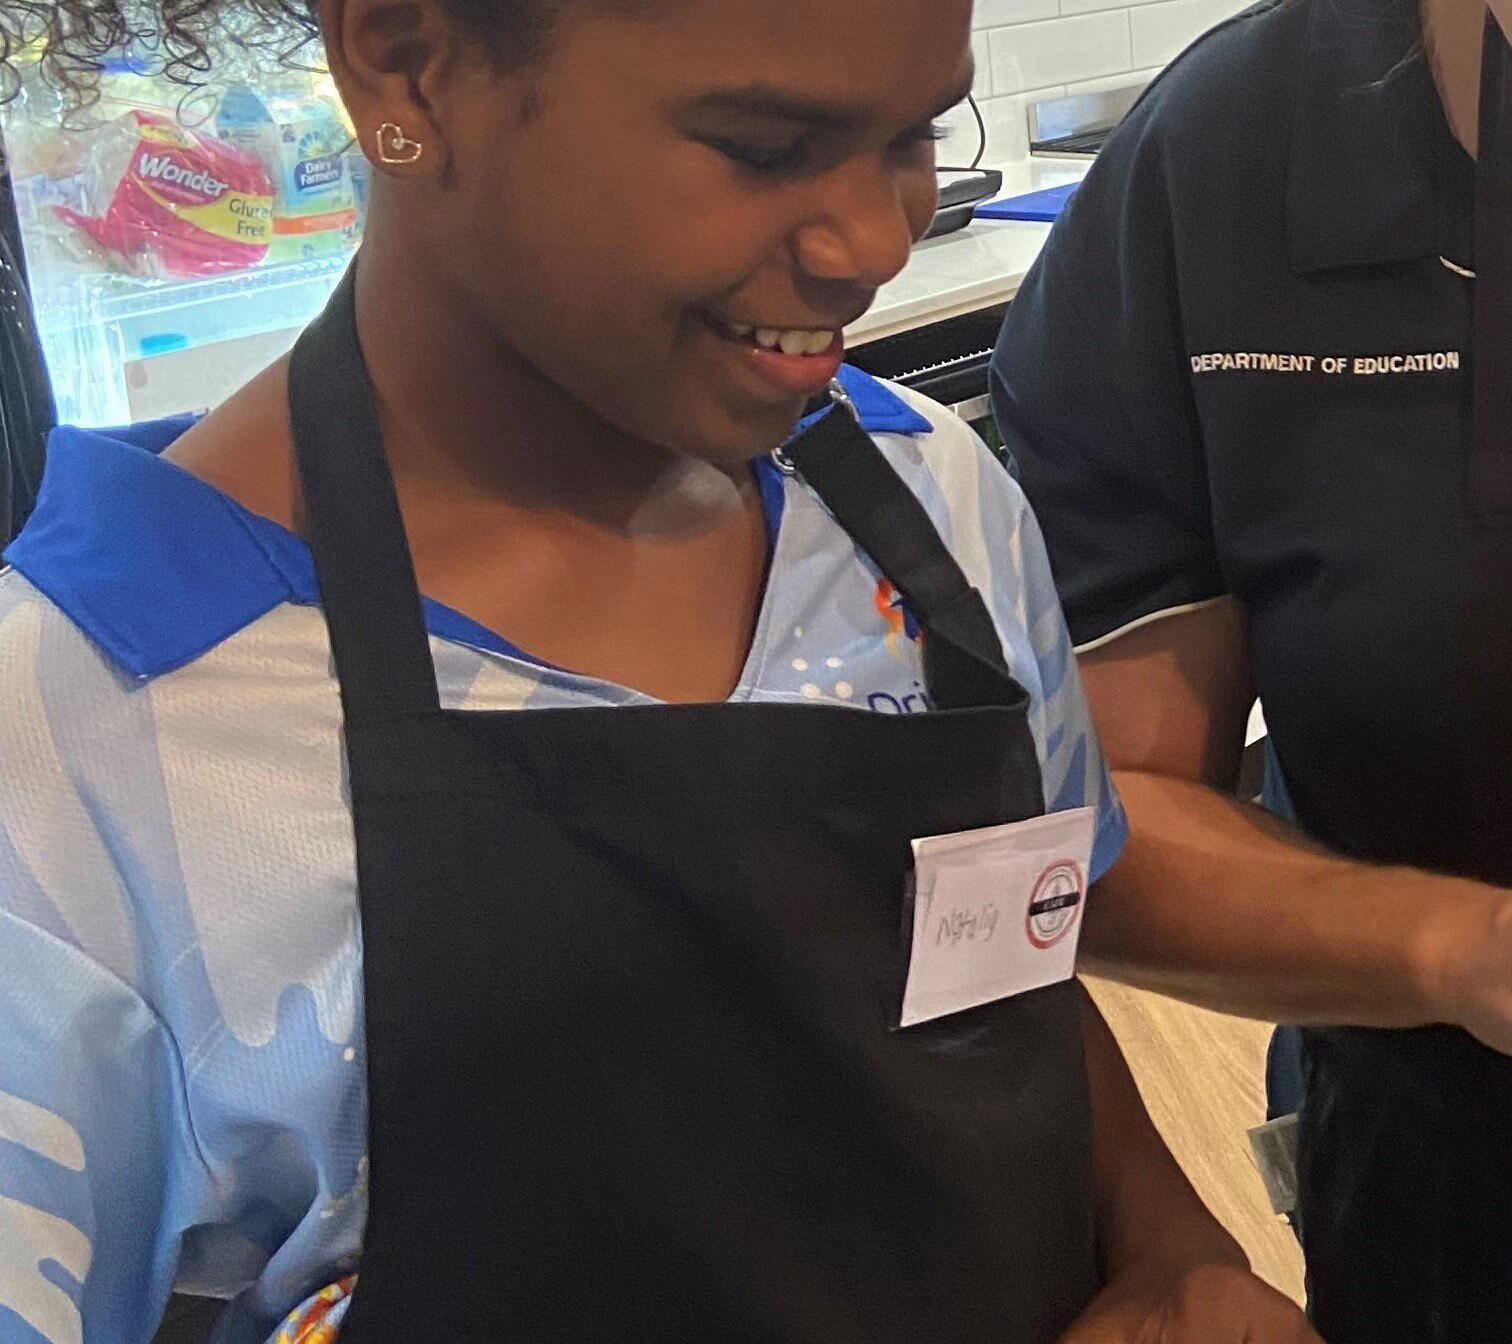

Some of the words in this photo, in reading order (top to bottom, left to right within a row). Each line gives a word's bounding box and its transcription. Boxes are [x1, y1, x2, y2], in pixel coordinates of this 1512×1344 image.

[138, 152, 229, 197] Wonder
[237, 220, 265, 237] Free
[1190, 352, 1315, 373] DEPARTMENT
[1321, 357, 1348, 374] OF
[1353, 351, 1460, 375] EDUCATION
